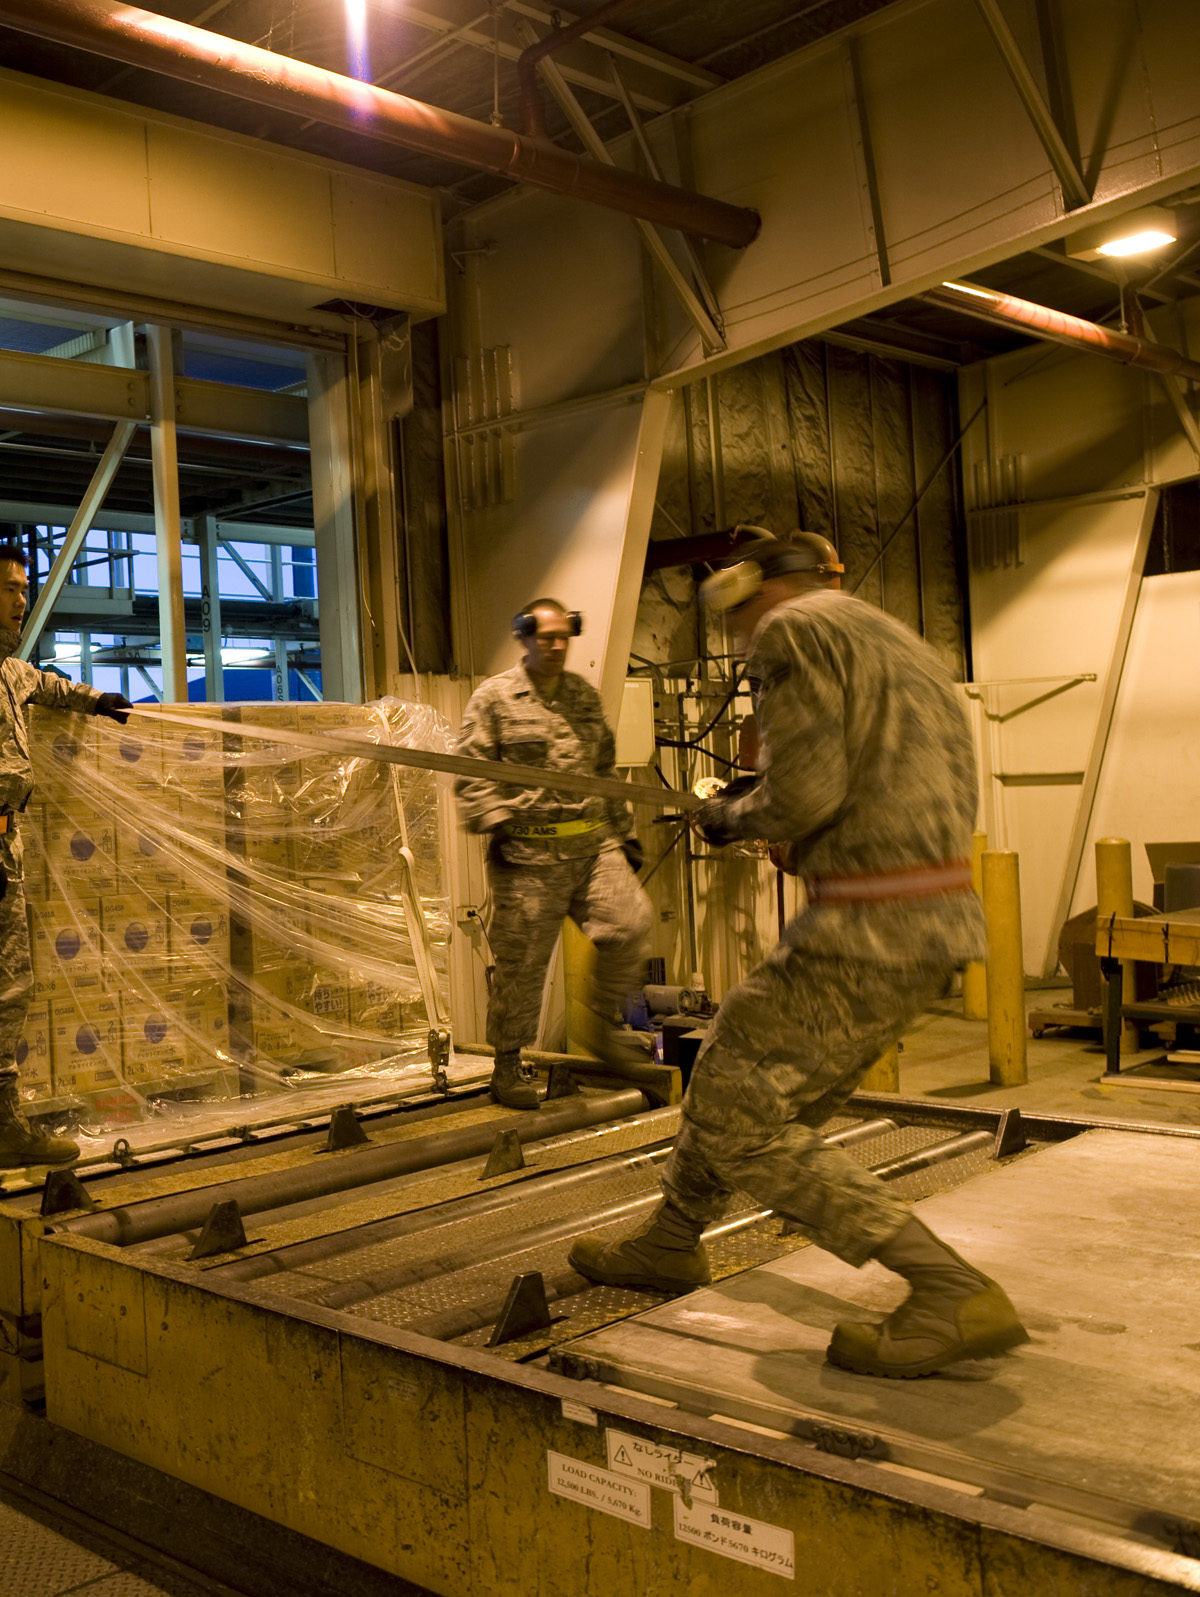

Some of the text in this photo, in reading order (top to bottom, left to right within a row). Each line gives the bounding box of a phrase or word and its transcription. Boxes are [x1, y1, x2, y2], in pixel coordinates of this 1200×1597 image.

[201, 585, 211, 633] A09
[512, 825, 558, 836] 730 AMS
[562, 1464, 637, 1498] LOAD CAPACITY:
[637, 1468, 652, 1479] NO
[557, 1478, 579, 1492] 12,500
[607, 1496, 627, 1510] 5,670
[710, 1513, 752, 1535] 負荷容量
[751, 1547, 794, 1569] キログラム
